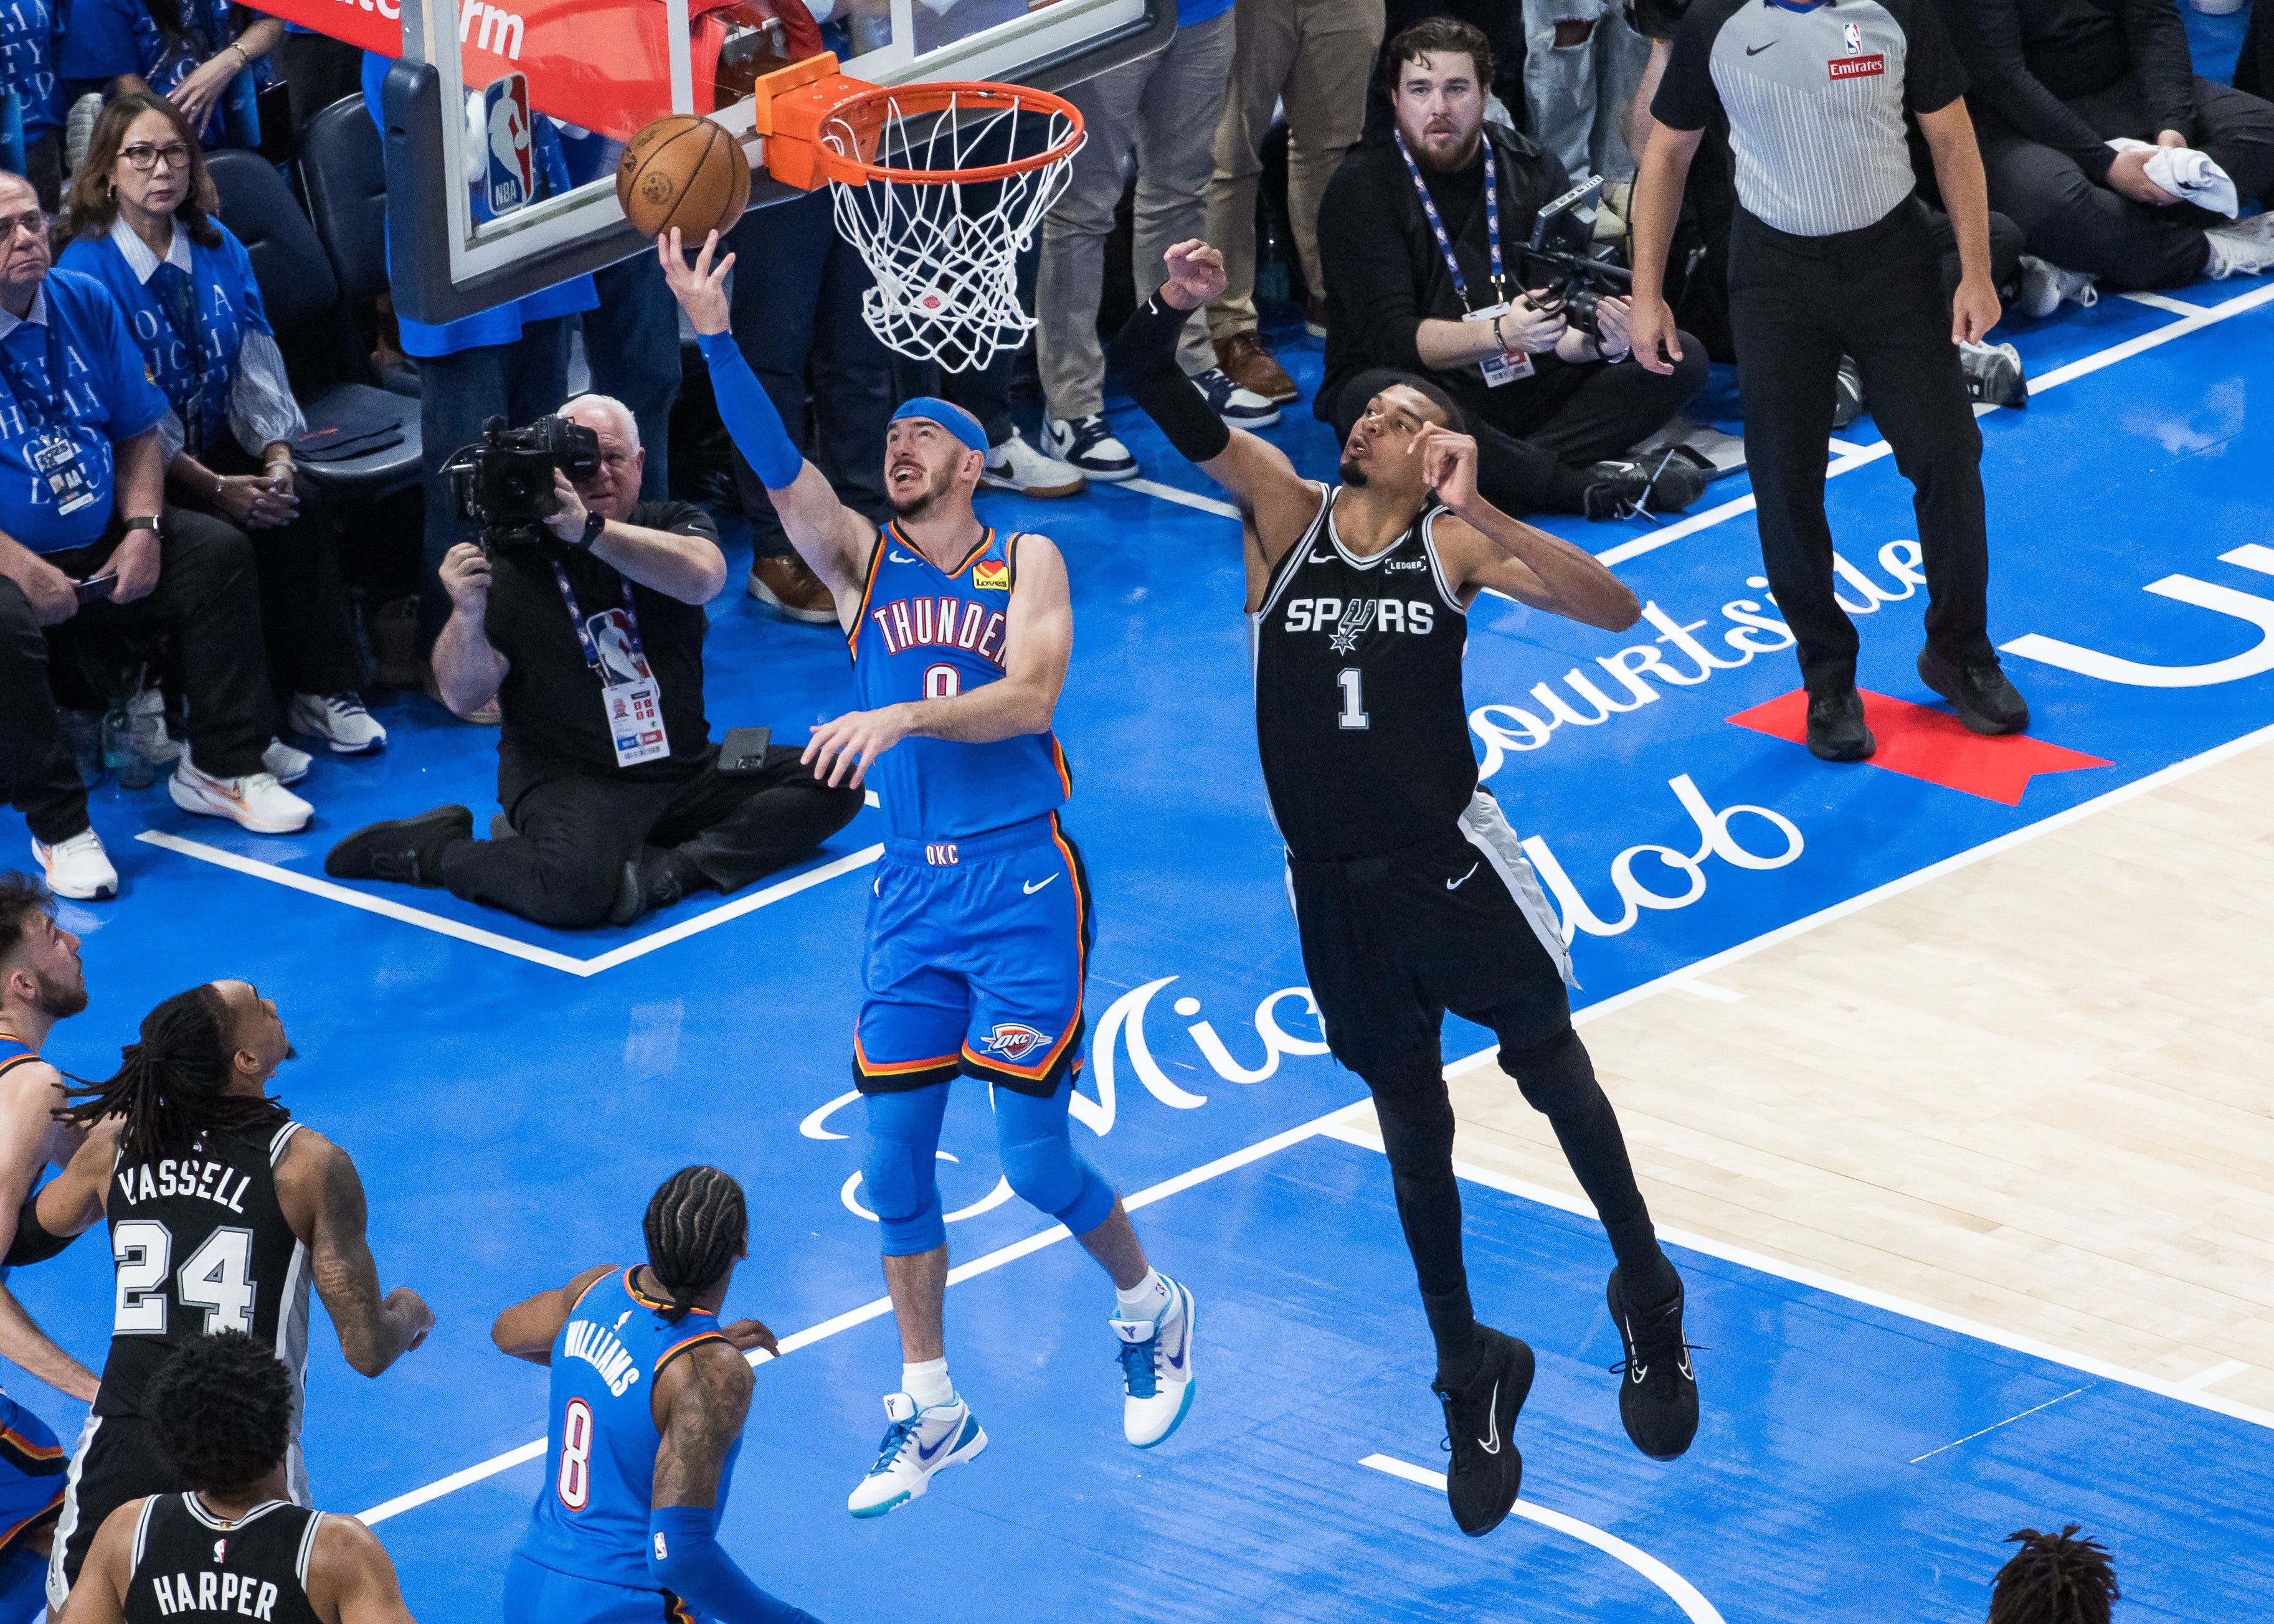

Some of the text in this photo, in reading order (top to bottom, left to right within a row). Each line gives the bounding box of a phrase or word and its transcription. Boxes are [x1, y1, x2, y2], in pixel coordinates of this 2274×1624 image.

[460, 0, 524, 60] rm
[1830, 60, 1883, 75] Emirates
[495, 179, 517, 206] NBA
[1390, 561, 1422, 570] LEDGER
[872, 597, 1007, 671] THUNDE
[1285, 598, 1434, 635] SPURS
[1337, 668, 1370, 729] 1
[925, 843, 959, 866] OKC
[992, 1033, 1030, 1049] OKC
[118, 1159, 251, 1214] VASSELL
[112, 1219, 257, 1339] 24
[564, 1320, 640, 1397] WILLIAMS
[558, 1397, 593, 1511] 8
[153, 1571, 278, 1622] HARPER
